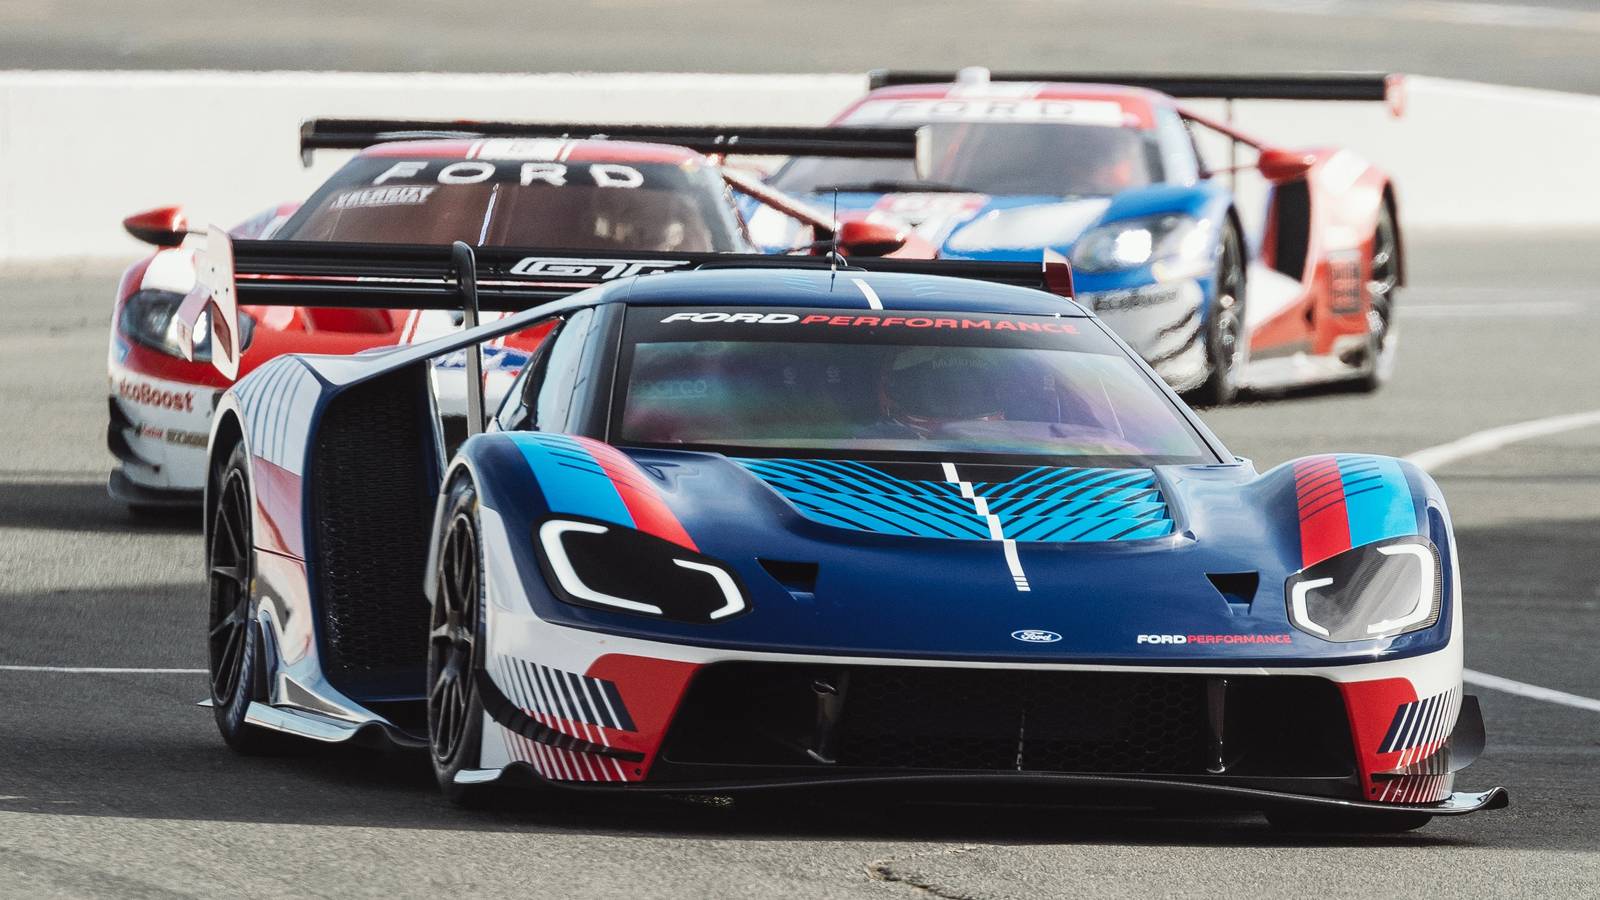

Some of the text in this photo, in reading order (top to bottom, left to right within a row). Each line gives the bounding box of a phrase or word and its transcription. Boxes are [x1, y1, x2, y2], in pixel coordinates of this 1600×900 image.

[887, 101, 1074, 121] FORD
[372, 161, 644, 189] FORD
[660, 312, 1080, 335] FORD PERFORMANCE
[1137, 634, 1292, 644] FORD PERFORMANCE
